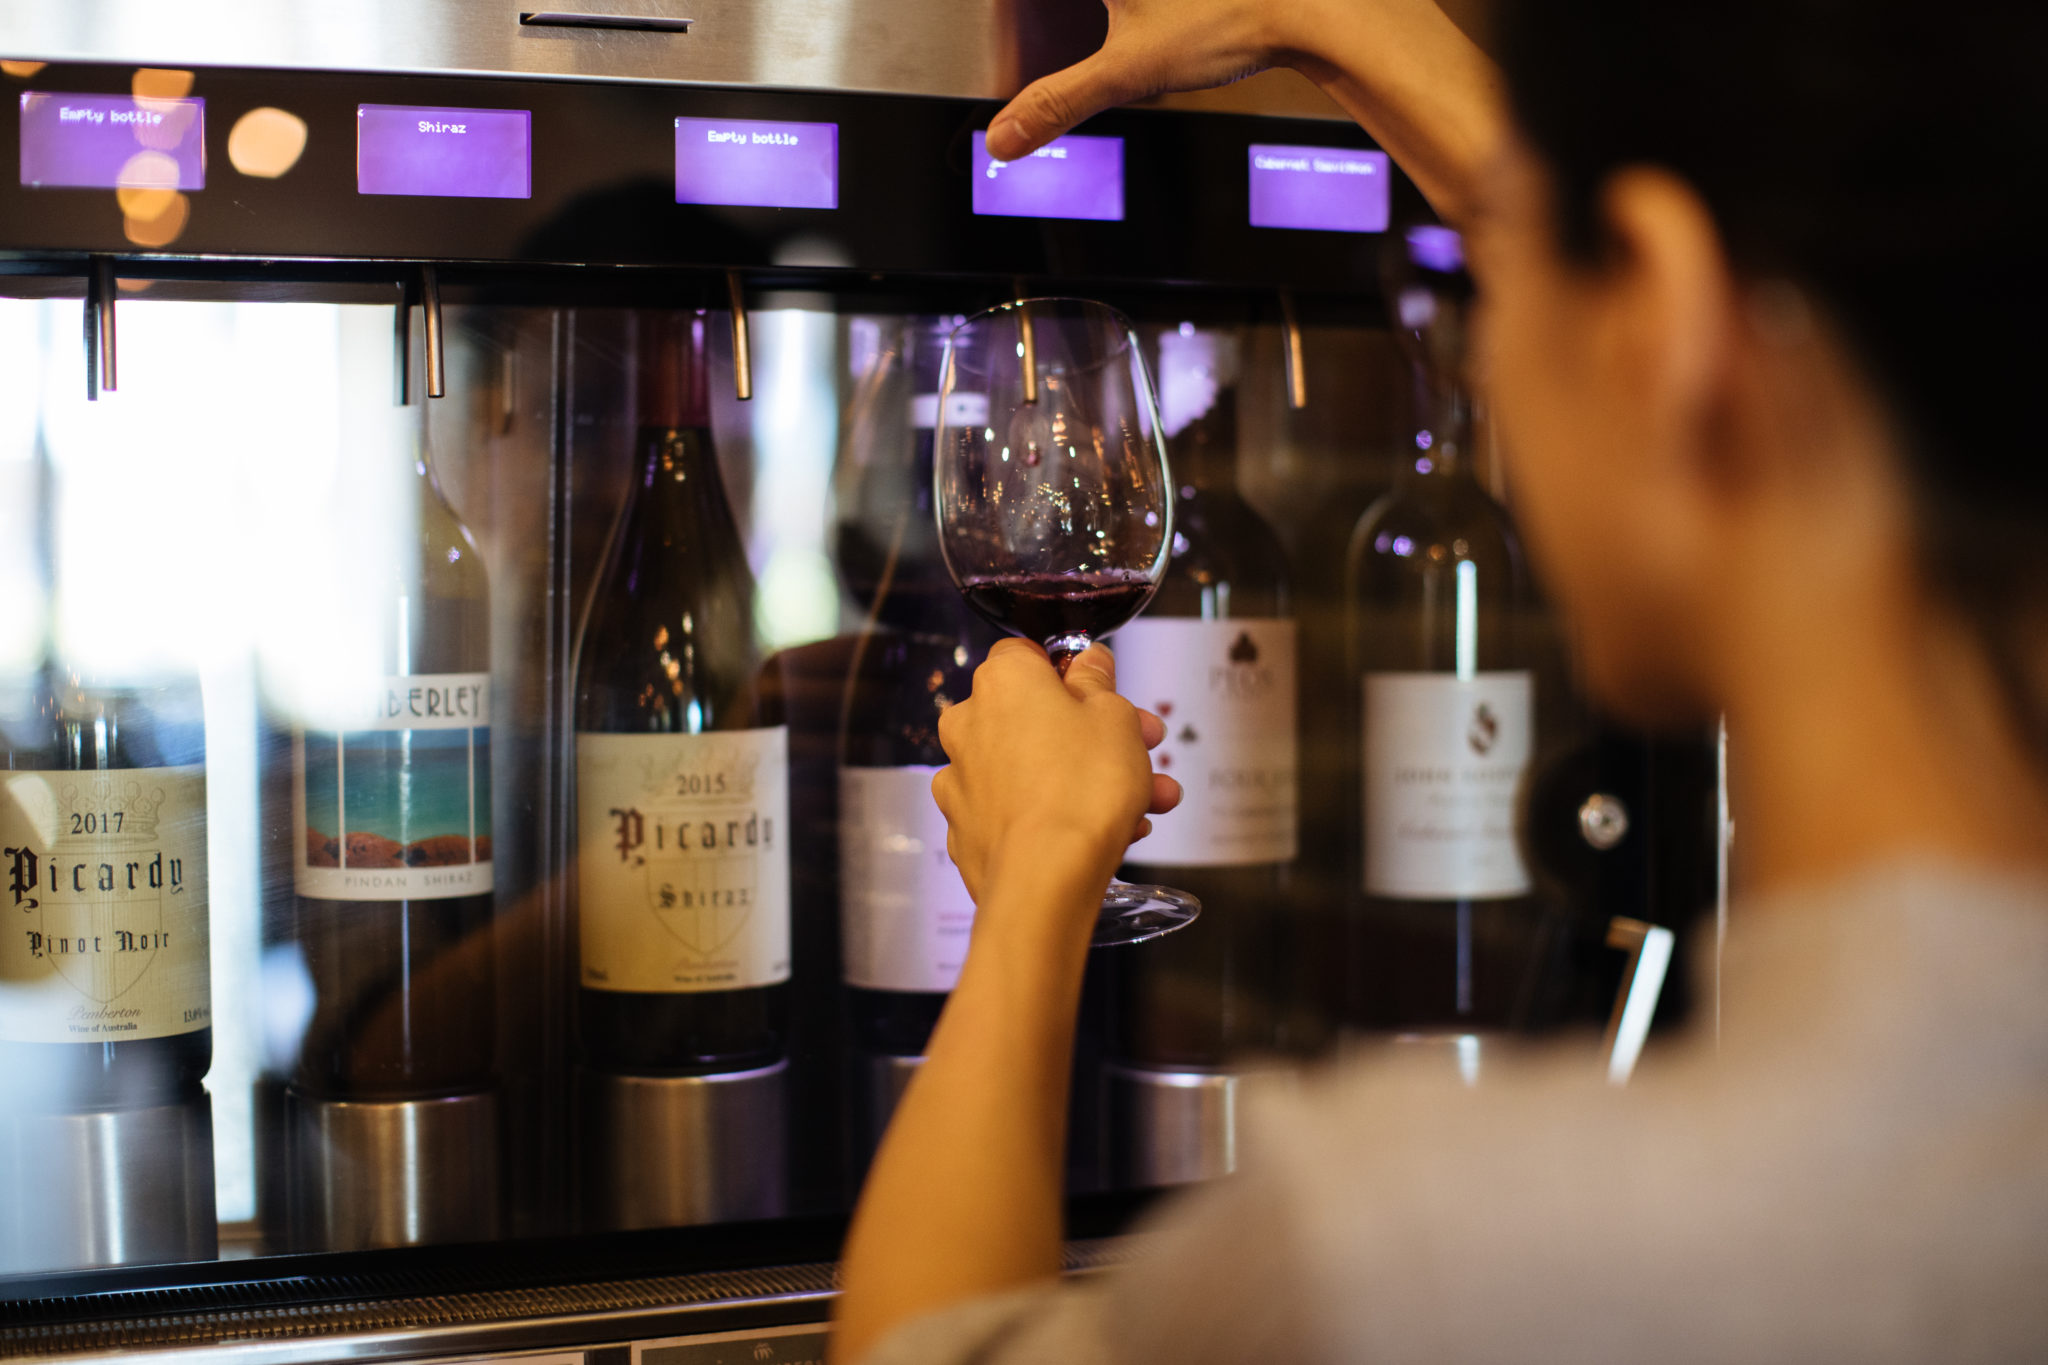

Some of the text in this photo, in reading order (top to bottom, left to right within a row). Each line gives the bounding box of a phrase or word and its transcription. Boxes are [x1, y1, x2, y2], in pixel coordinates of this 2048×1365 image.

[60, 107, 163, 124] Empty bottle
[418, 121, 467, 134] Shiraz
[707, 130, 799, 145] Empty bottle
[677, 773, 726, 796] 2015
[71, 812, 124, 835] 2017
[4, 846, 184, 913] Picardy
[345, 871, 473, 888] PINDAN SHIRAZ
[26, 929, 170, 958] Pinot Noir
[69, 1022, 138, 1034] Wine of Australia
